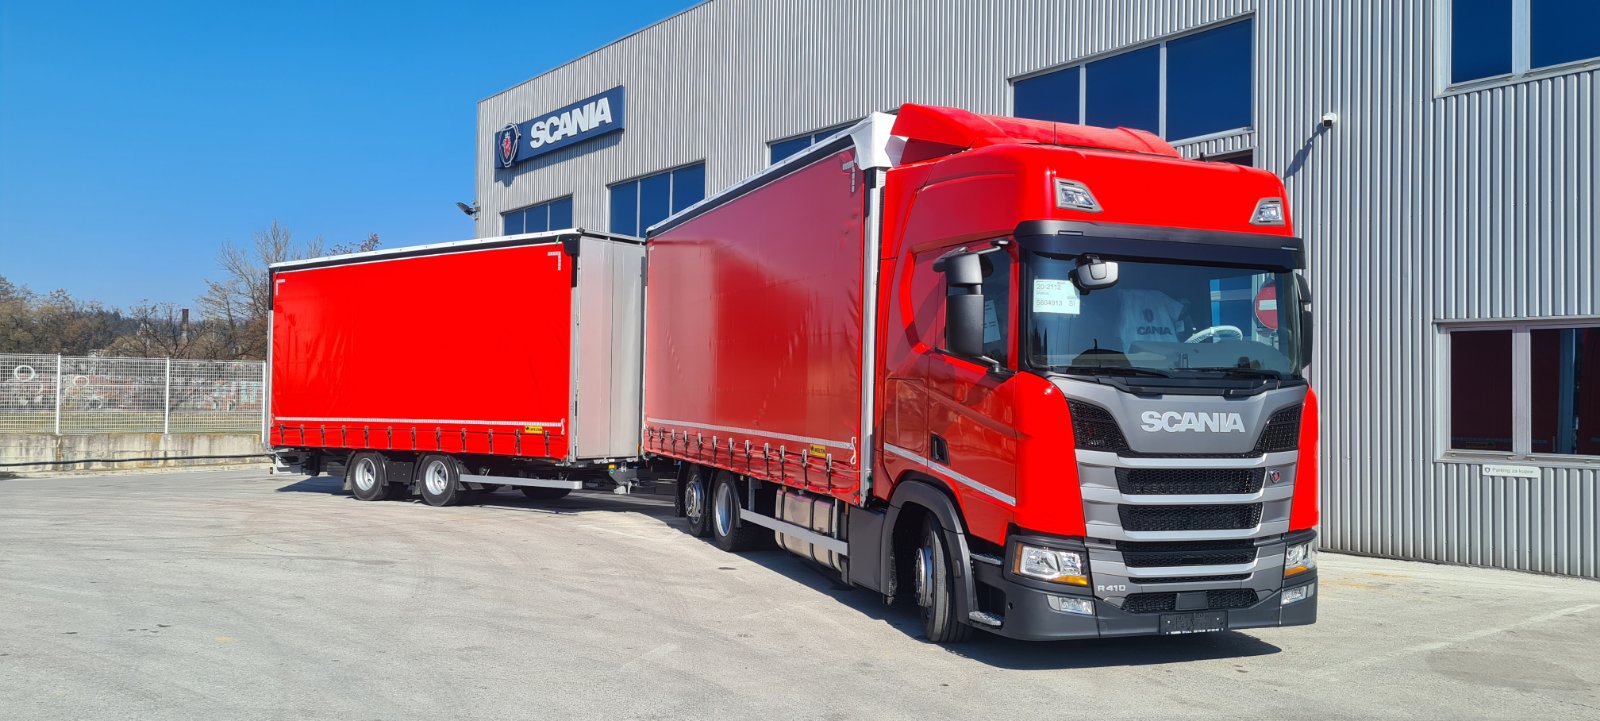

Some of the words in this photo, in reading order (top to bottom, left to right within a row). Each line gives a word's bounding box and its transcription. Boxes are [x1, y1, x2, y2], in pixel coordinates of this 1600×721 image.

[530, 97, 612, 148] SCANIA
[1136, 326, 1173, 335] CANIA
[1140, 411, 1245, 432] SCANIA
